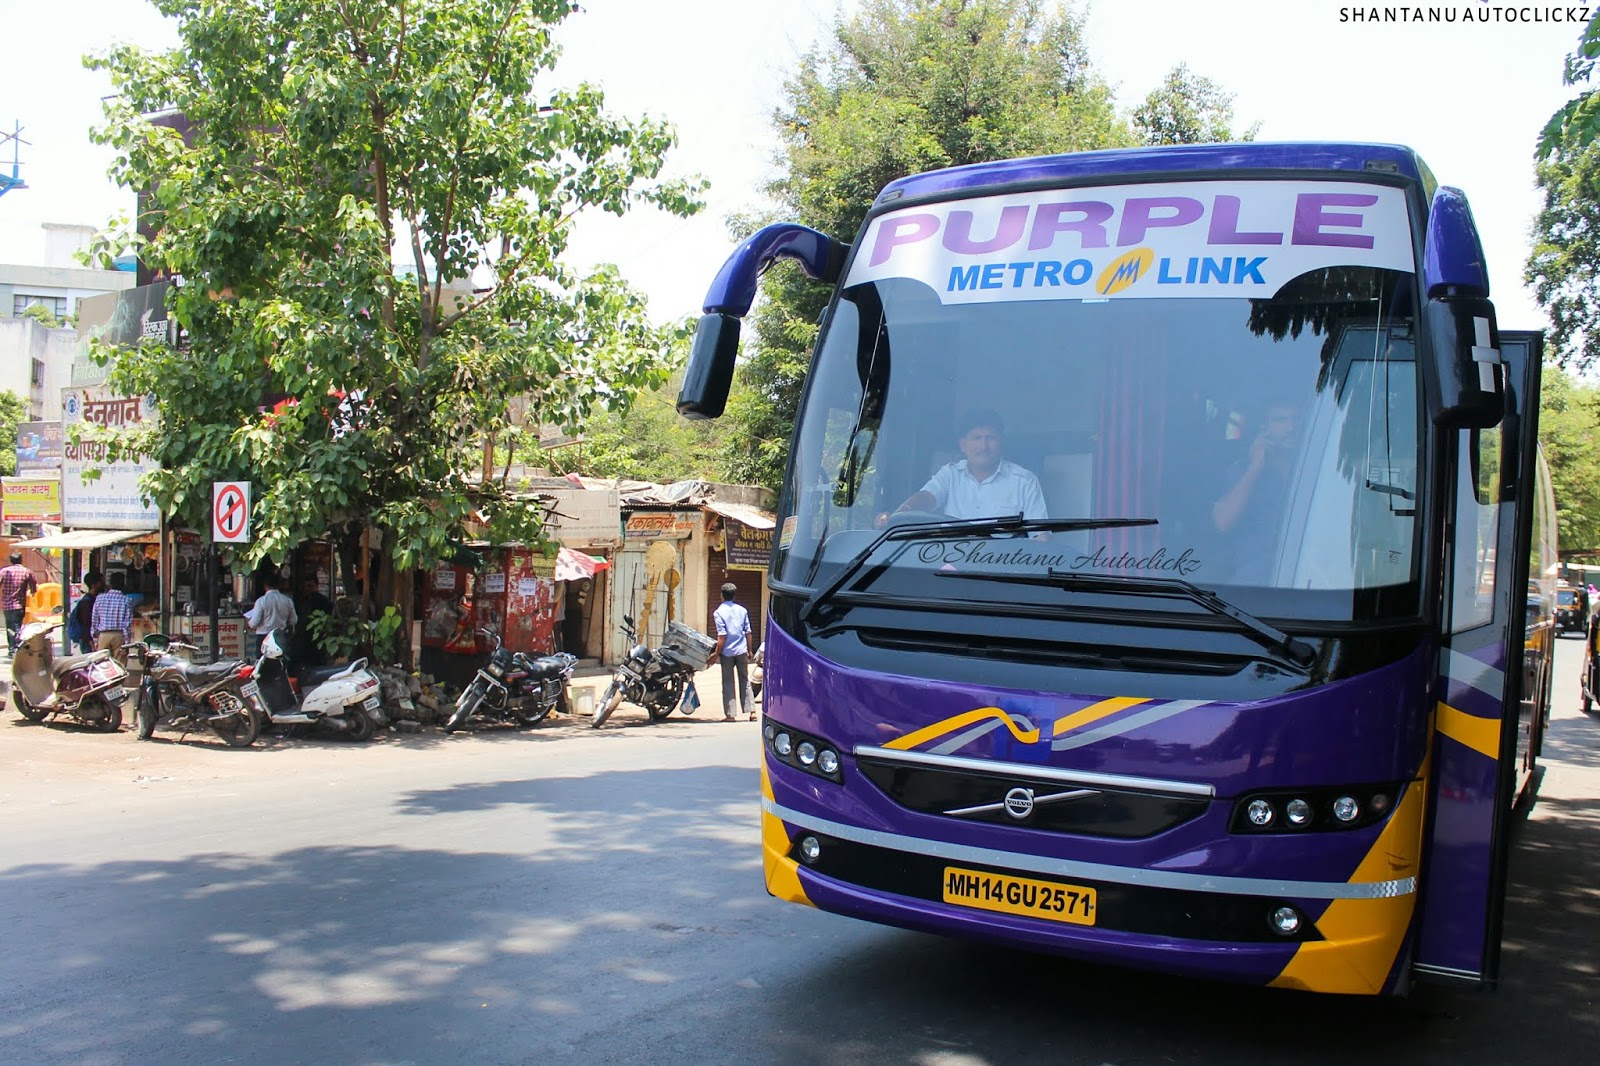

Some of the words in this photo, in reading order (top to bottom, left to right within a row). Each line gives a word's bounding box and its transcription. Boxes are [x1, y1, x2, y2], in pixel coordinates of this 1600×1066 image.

[870, 193, 1378, 268] PURPLE
[947, 257, 1093, 292] METRO
[1157, 256, 1268, 285] LINK
[1006, 799, 1032, 807] VOLVO
[948, 873, 1091, 917] MH14GU2571
